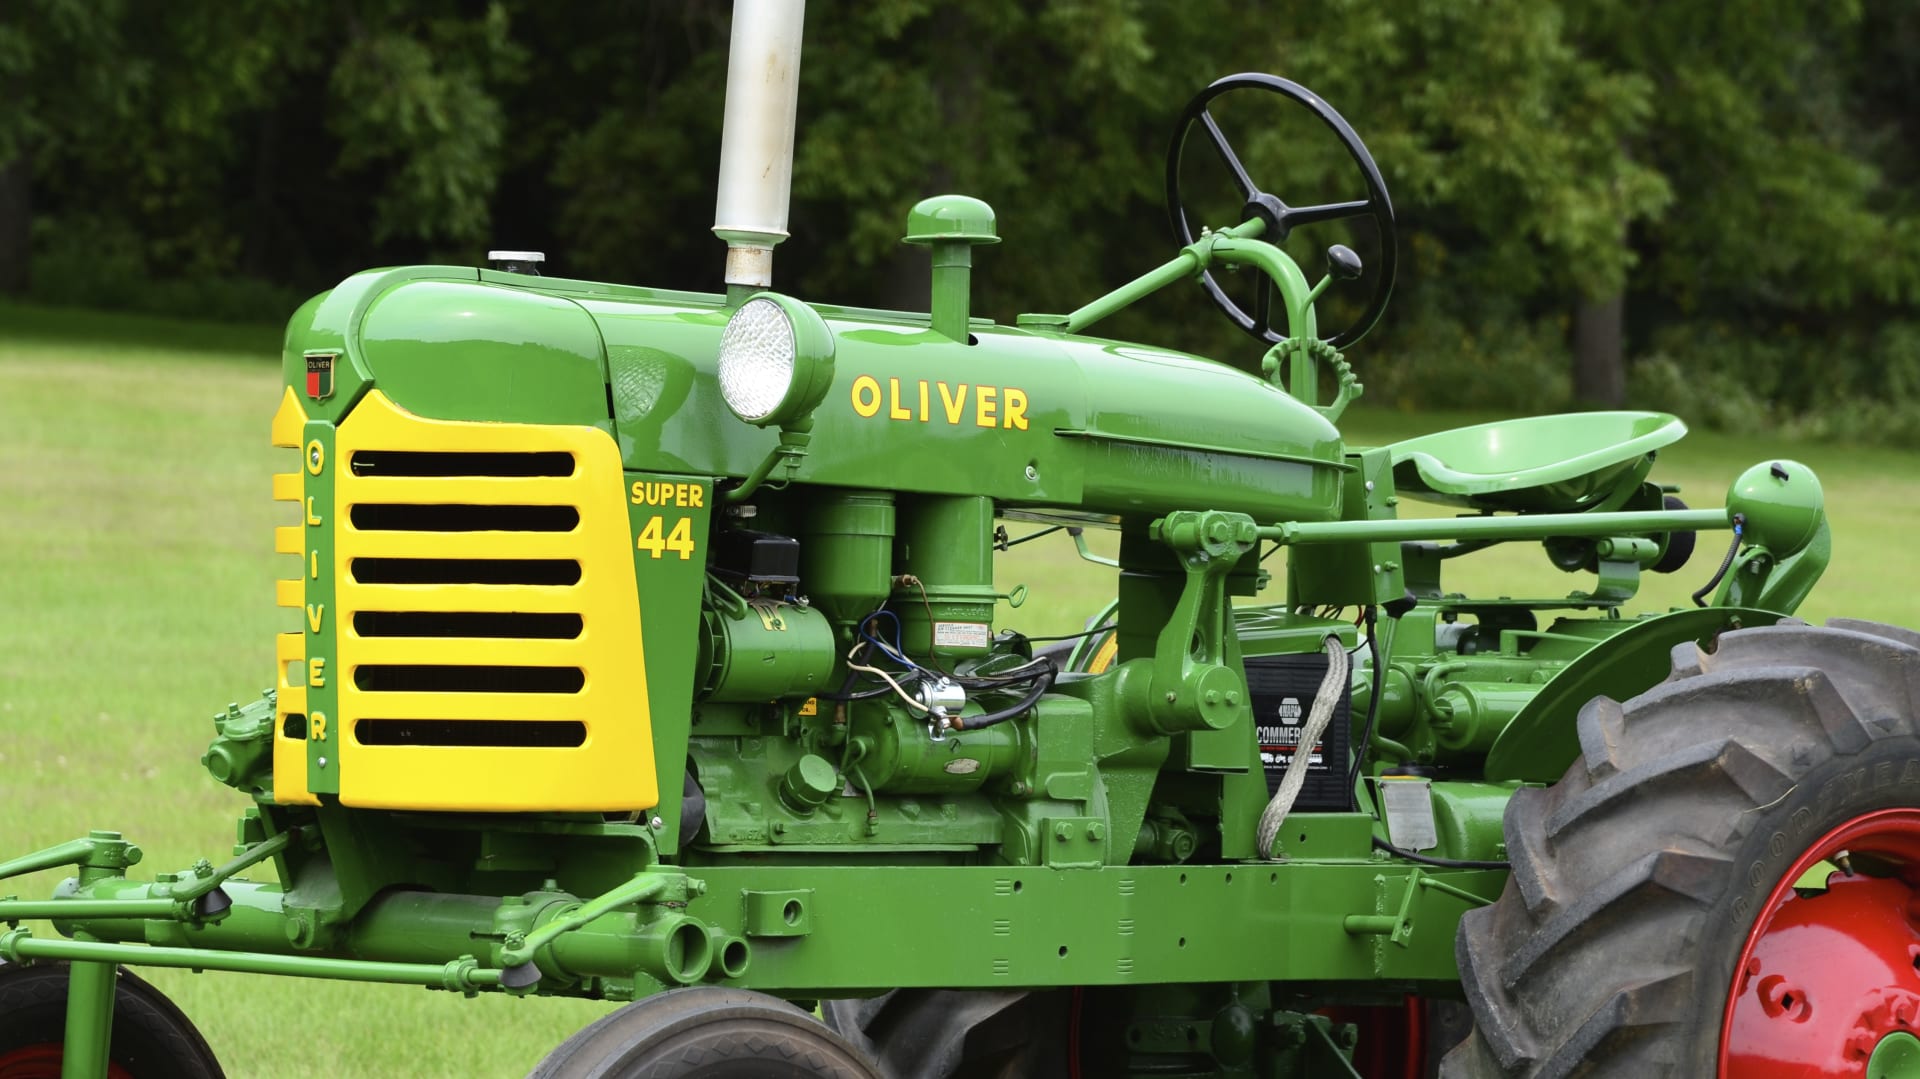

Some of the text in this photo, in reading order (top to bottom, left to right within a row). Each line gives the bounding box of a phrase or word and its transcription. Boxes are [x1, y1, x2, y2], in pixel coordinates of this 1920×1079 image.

[308, 361, 330, 369] OLIVER
[851, 374, 1029, 431] OLIVER
[631, 481, 704, 508] SUPER
[637, 515, 695, 561] 44
[305, 438, 327, 741] OLIVER
[1256, 726, 1323, 744] COMMER
